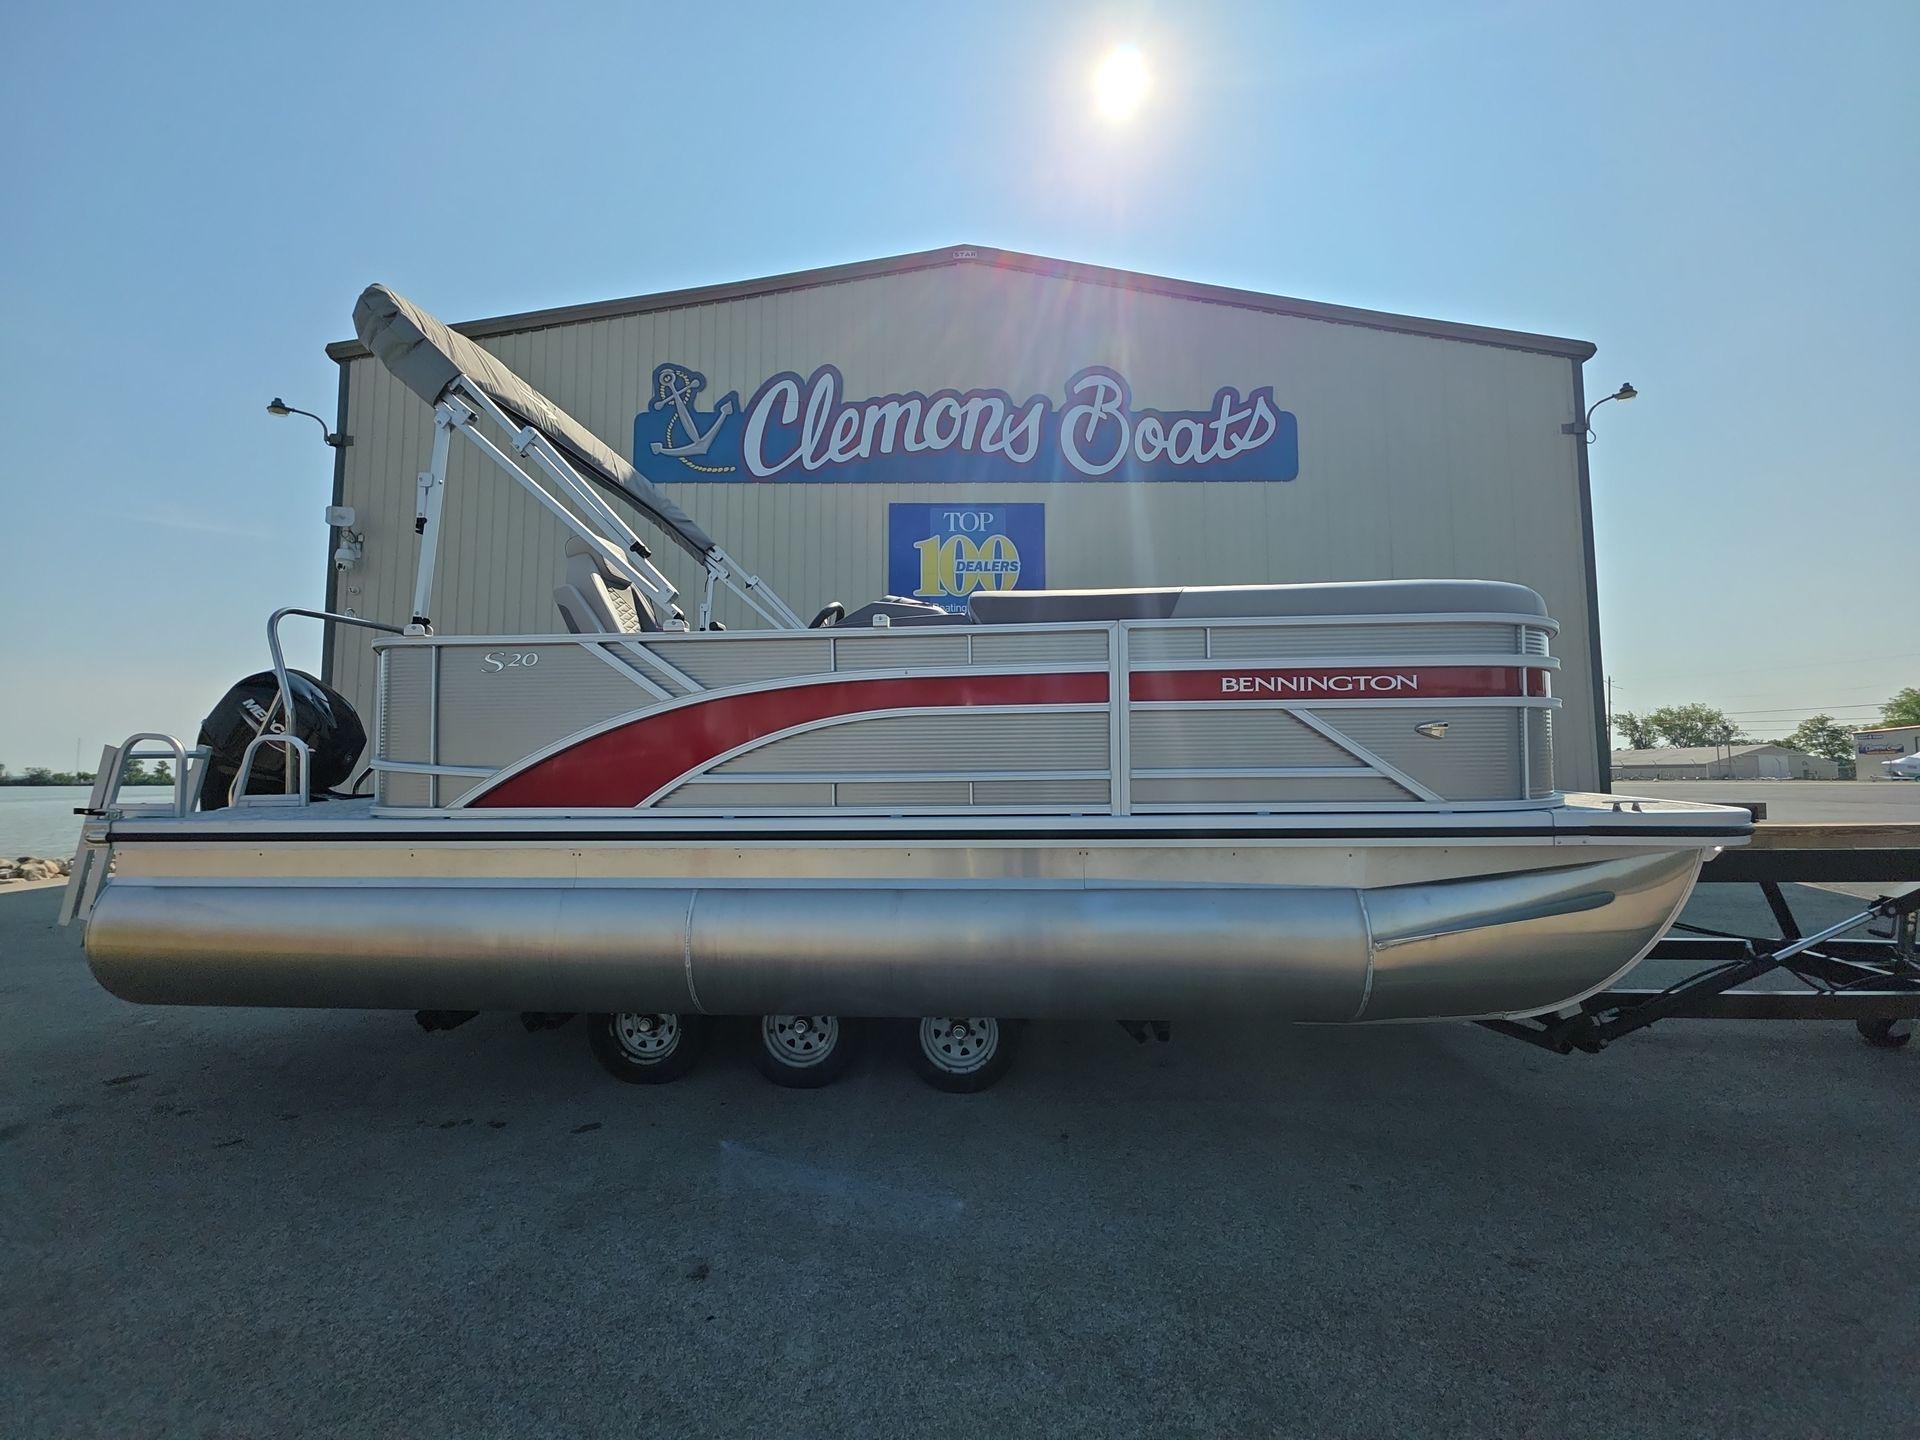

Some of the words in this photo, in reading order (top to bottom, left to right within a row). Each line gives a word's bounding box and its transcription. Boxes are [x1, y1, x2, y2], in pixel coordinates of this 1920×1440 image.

[743, 373, 1044, 477] Clemons
[1060, 374, 1277, 476] Boats
[943, 512, 994, 532] TOP
[912, 534, 1020, 597] 100
[955, 560, 1019, 573] DEALERS
[1221, 674, 1418, 693] BENNINGTON
